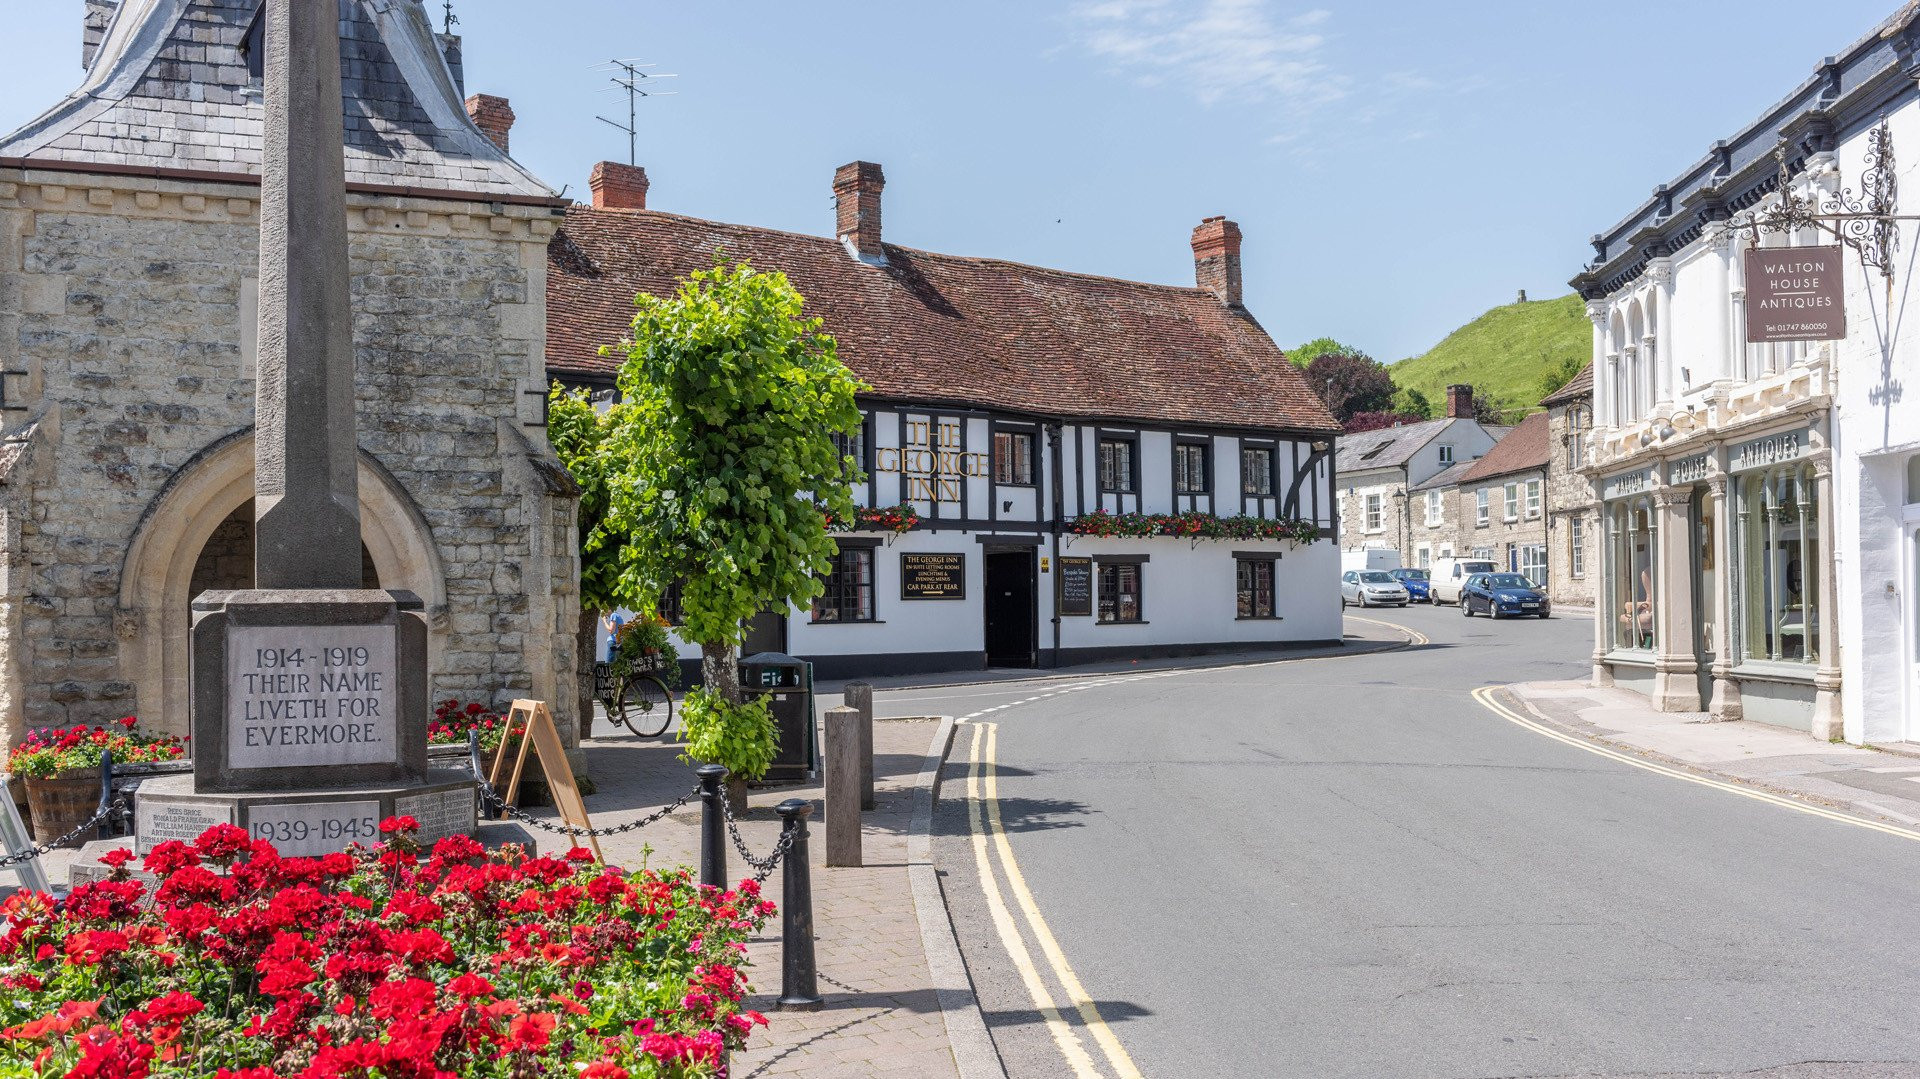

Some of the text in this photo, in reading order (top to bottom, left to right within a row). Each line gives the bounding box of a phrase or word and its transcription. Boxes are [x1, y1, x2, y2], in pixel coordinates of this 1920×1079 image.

[1764, 262, 1824, 274] WALTON
[1770, 278, 1819, 289] HOUSE
[1760, 296, 1832, 309] ANTIQUES
[1800, 322, 1828, 331] 860050
[906, 421, 961, 448] THE
[878, 447, 989, 477] GEORGE
[1739, 434, 1800, 468] ANTIQUES
[1675, 456, 1707, 481] HOUSE
[909, 477, 960, 503] INN
[243, 672, 382, 694] THEIR NAME
[245, 698, 380, 720] LIVETH FOR
[245, 723, 381, 746] EVERMORE.
[154, 822, 183, 830] WILLIAM
